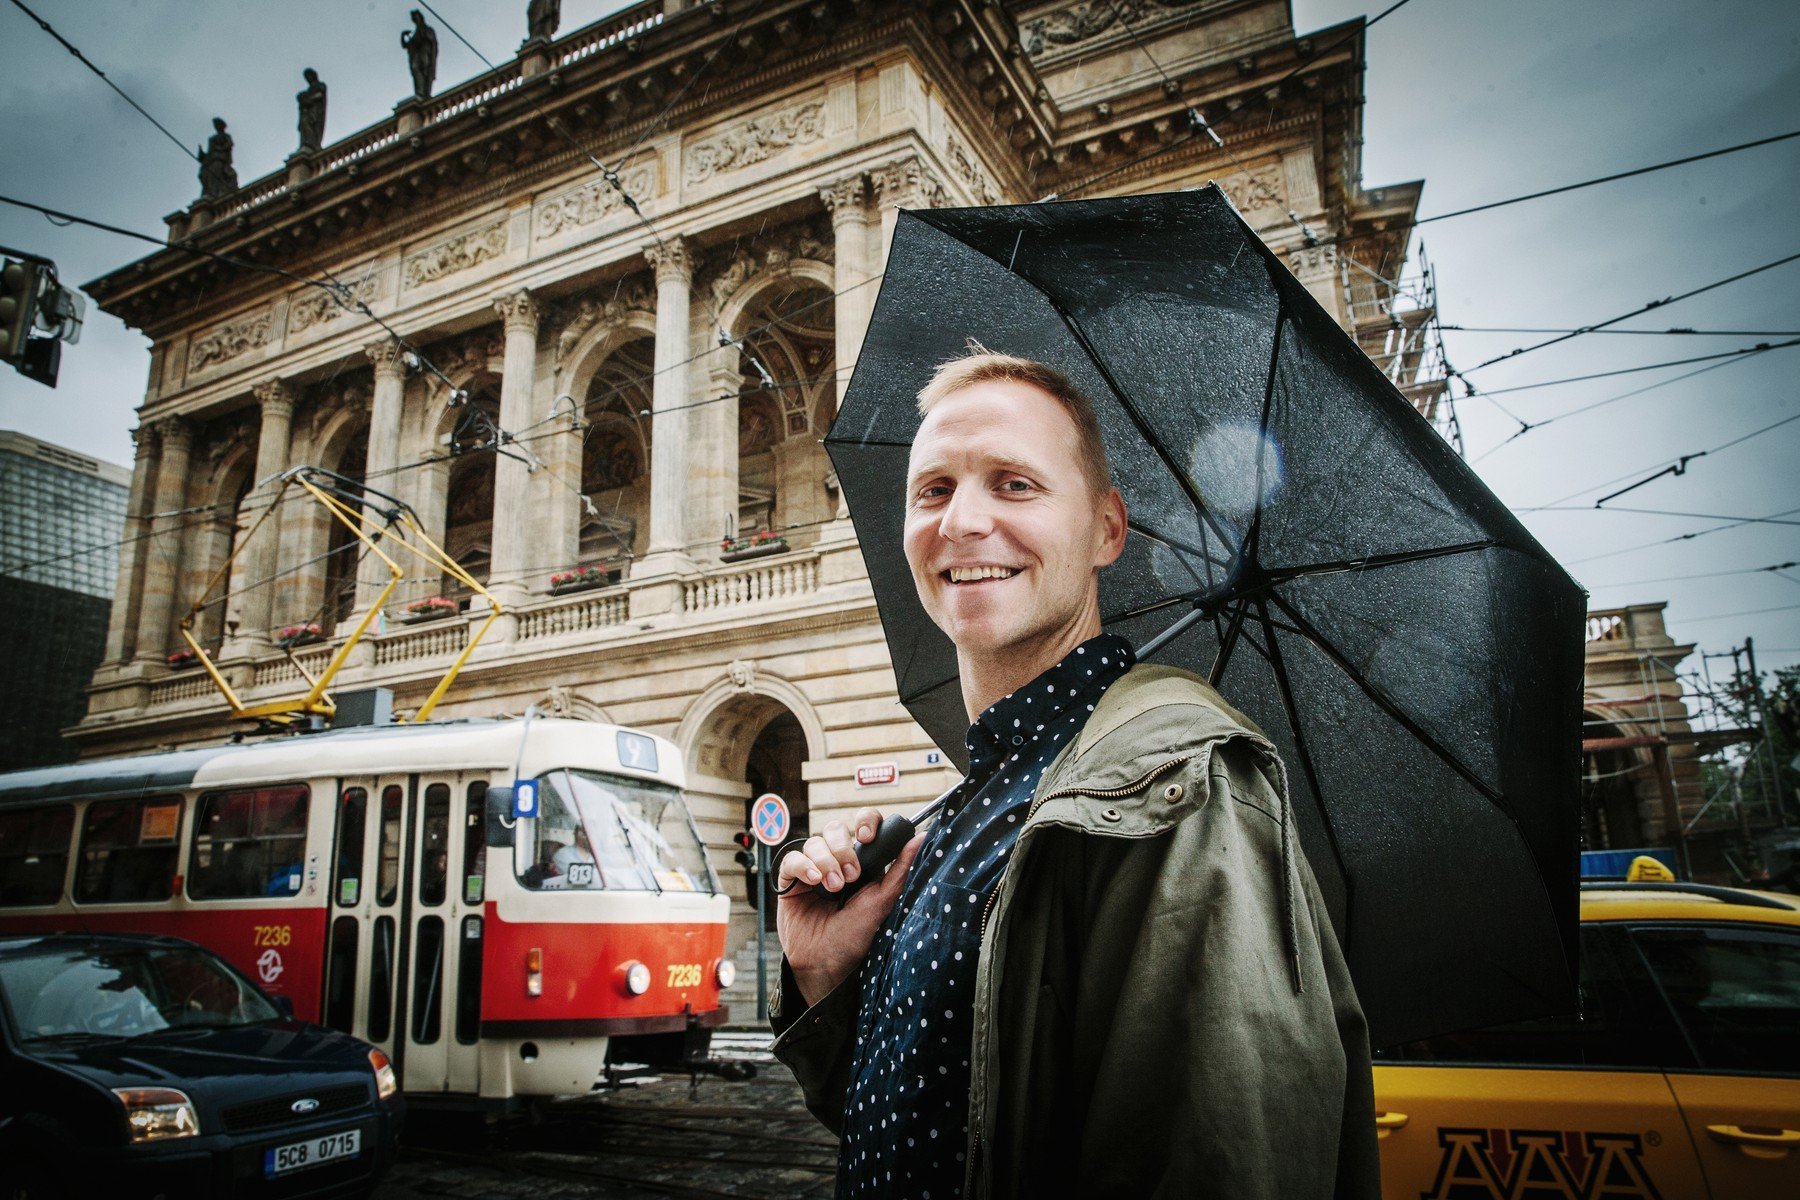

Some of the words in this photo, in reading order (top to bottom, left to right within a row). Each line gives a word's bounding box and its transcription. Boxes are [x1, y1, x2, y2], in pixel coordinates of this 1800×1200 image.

[625, 736, 642, 766] 9
[517, 784, 534, 812] 9
[569, 864, 592, 885] 813
[253, 925, 292, 947] 7236
[667, 963, 702, 988] 7236
[278, 1144, 308, 1169] 5C8
[319, 1132, 355, 1159] 0715
